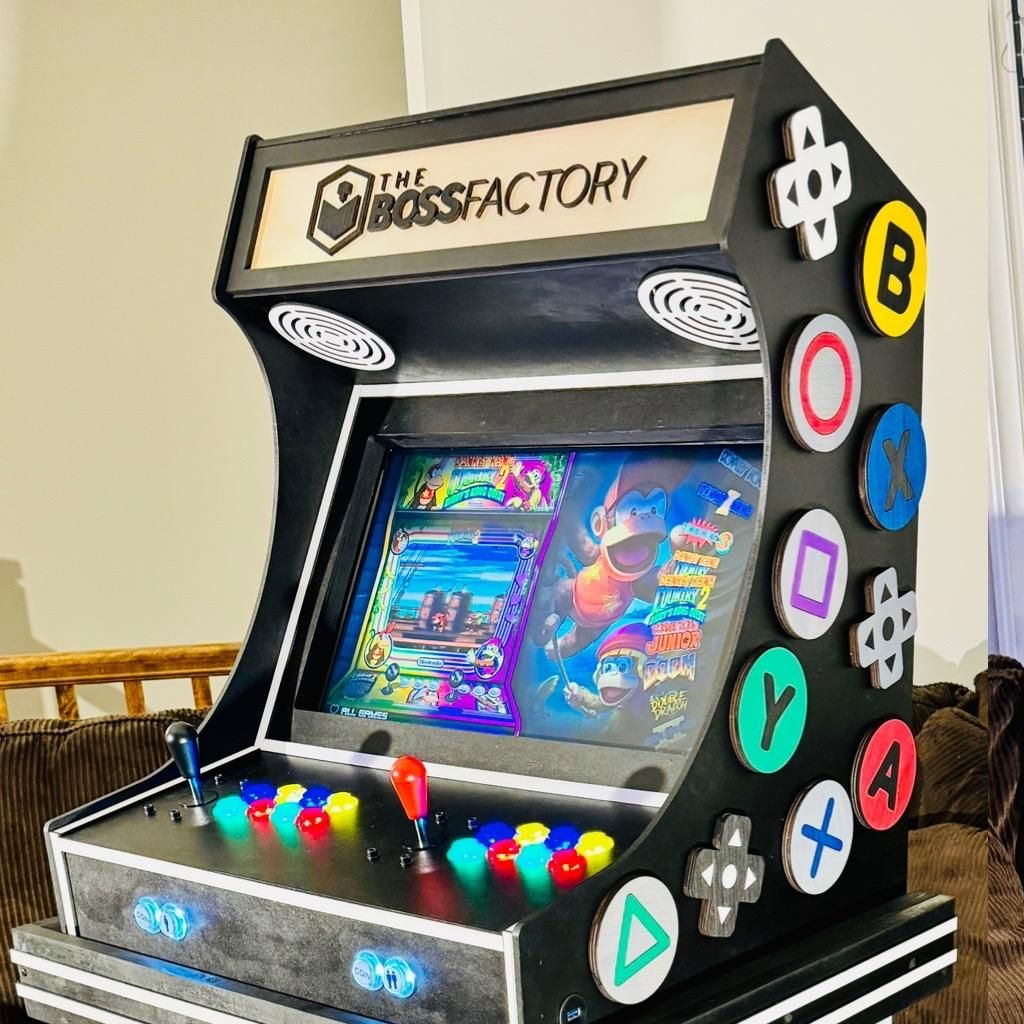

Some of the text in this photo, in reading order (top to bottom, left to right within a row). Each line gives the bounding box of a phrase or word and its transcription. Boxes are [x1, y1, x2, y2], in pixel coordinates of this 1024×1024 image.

[380, 167, 429, 193] THE
[367, 155, 648, 232] BOSSFACTORY
[877, 221, 916, 315] B
[882, 429, 915, 512] X
[696, 586, 711, 610] 2
[645, 630, 702, 655] JUNIOR
[341, 707, 356, 717] ALL
[650, 690, 687, 713] DOUBLE
[653, 702, 688, 720] DRAGON
[760, 671, 796, 752] Y
[866, 741, 903, 812] A
